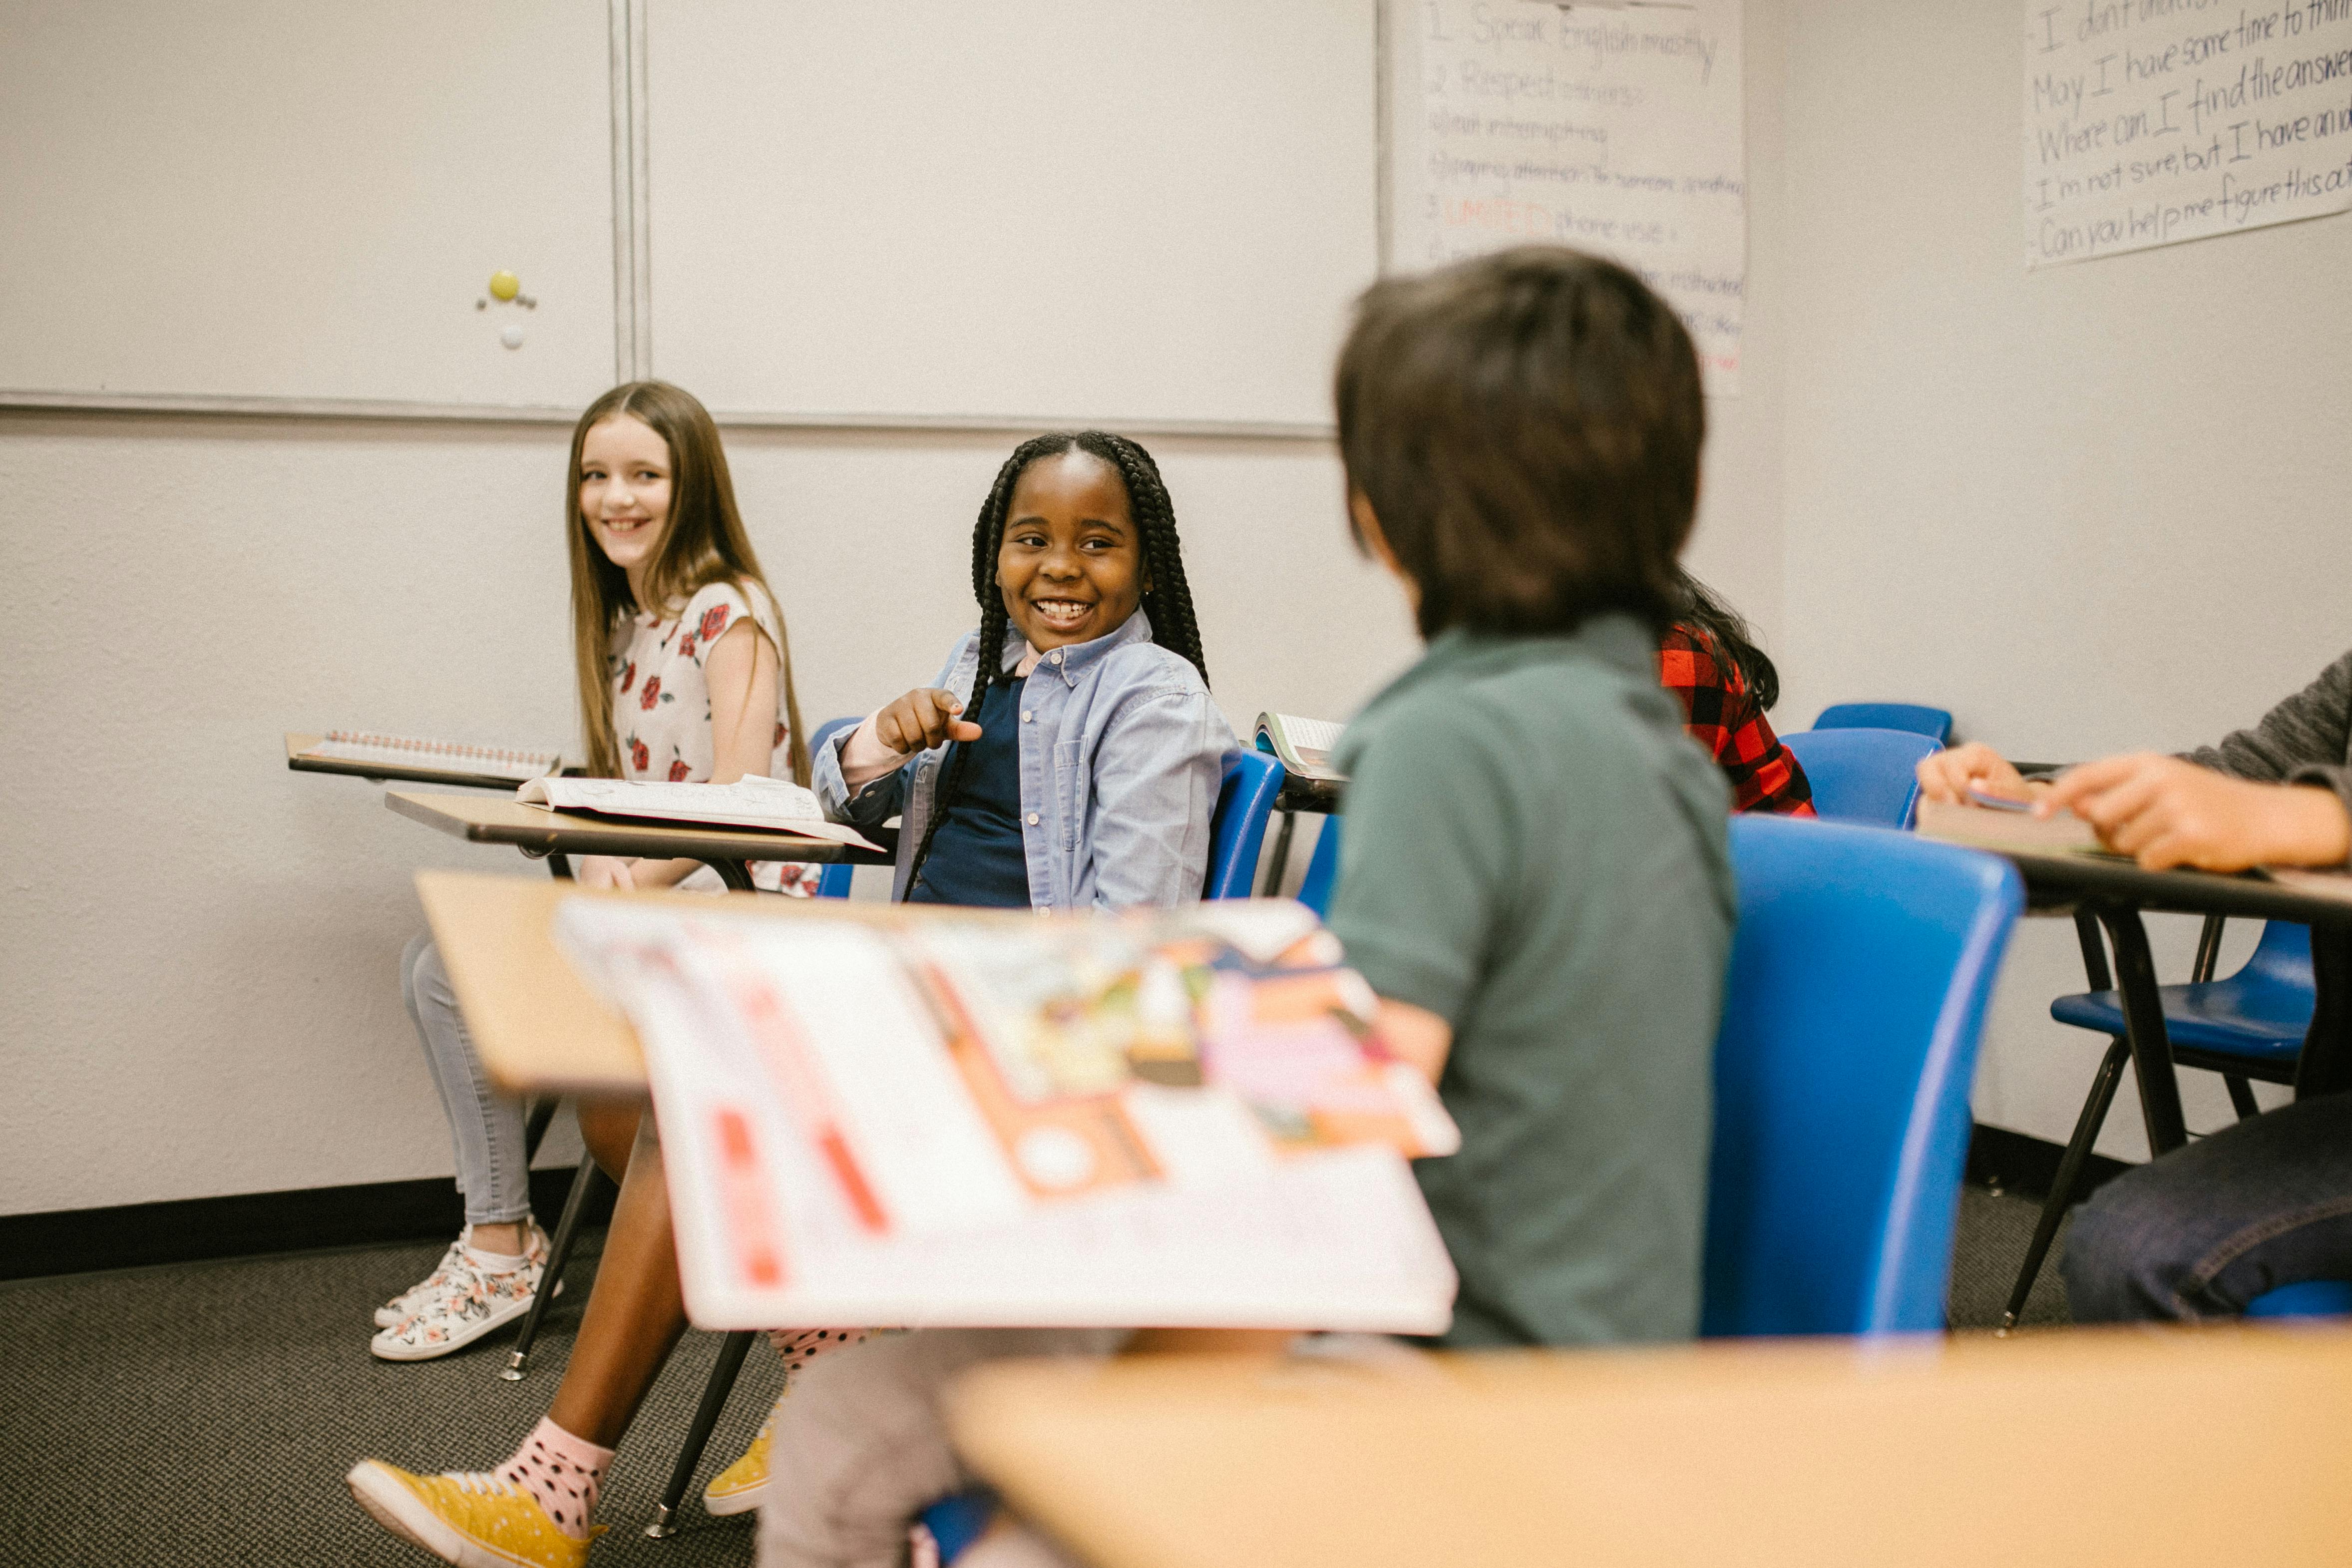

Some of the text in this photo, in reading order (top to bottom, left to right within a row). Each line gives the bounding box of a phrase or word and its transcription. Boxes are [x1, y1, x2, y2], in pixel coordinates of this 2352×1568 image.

[1559, 14, 1638, 72] English
[2033, 73, 2085, 120] May
[2092, 54, 2118, 96] I
[2126, 46, 2178, 82] have
[2183, 30, 2230, 65] some
[2235, 9, 2279, 48] time
[2285, 0, 2302, 37] to
[2039, 5, 2064, 52] I
[2038, 120, 2108, 164] Where
[2114, 110, 2147, 146] can
[2153, 90, 2181, 138] I
[2188, 64, 2246, 134] find
[2249, 56, 2284, 100] the
[2088, 162, 2122, 192] not
[2184, 134, 2222, 171] but
[2228, 120, 2252, 163] I
[2256, 119, 2310, 149] have
[2040, 217, 2083, 259] Can
[2087, 220, 2123, 256] you
[2129, 202, 2182, 241] help
[2184, 197, 2215, 220] me
[2217, 172, 2282, 224] figure
[2285, 167, 2322, 200] this
